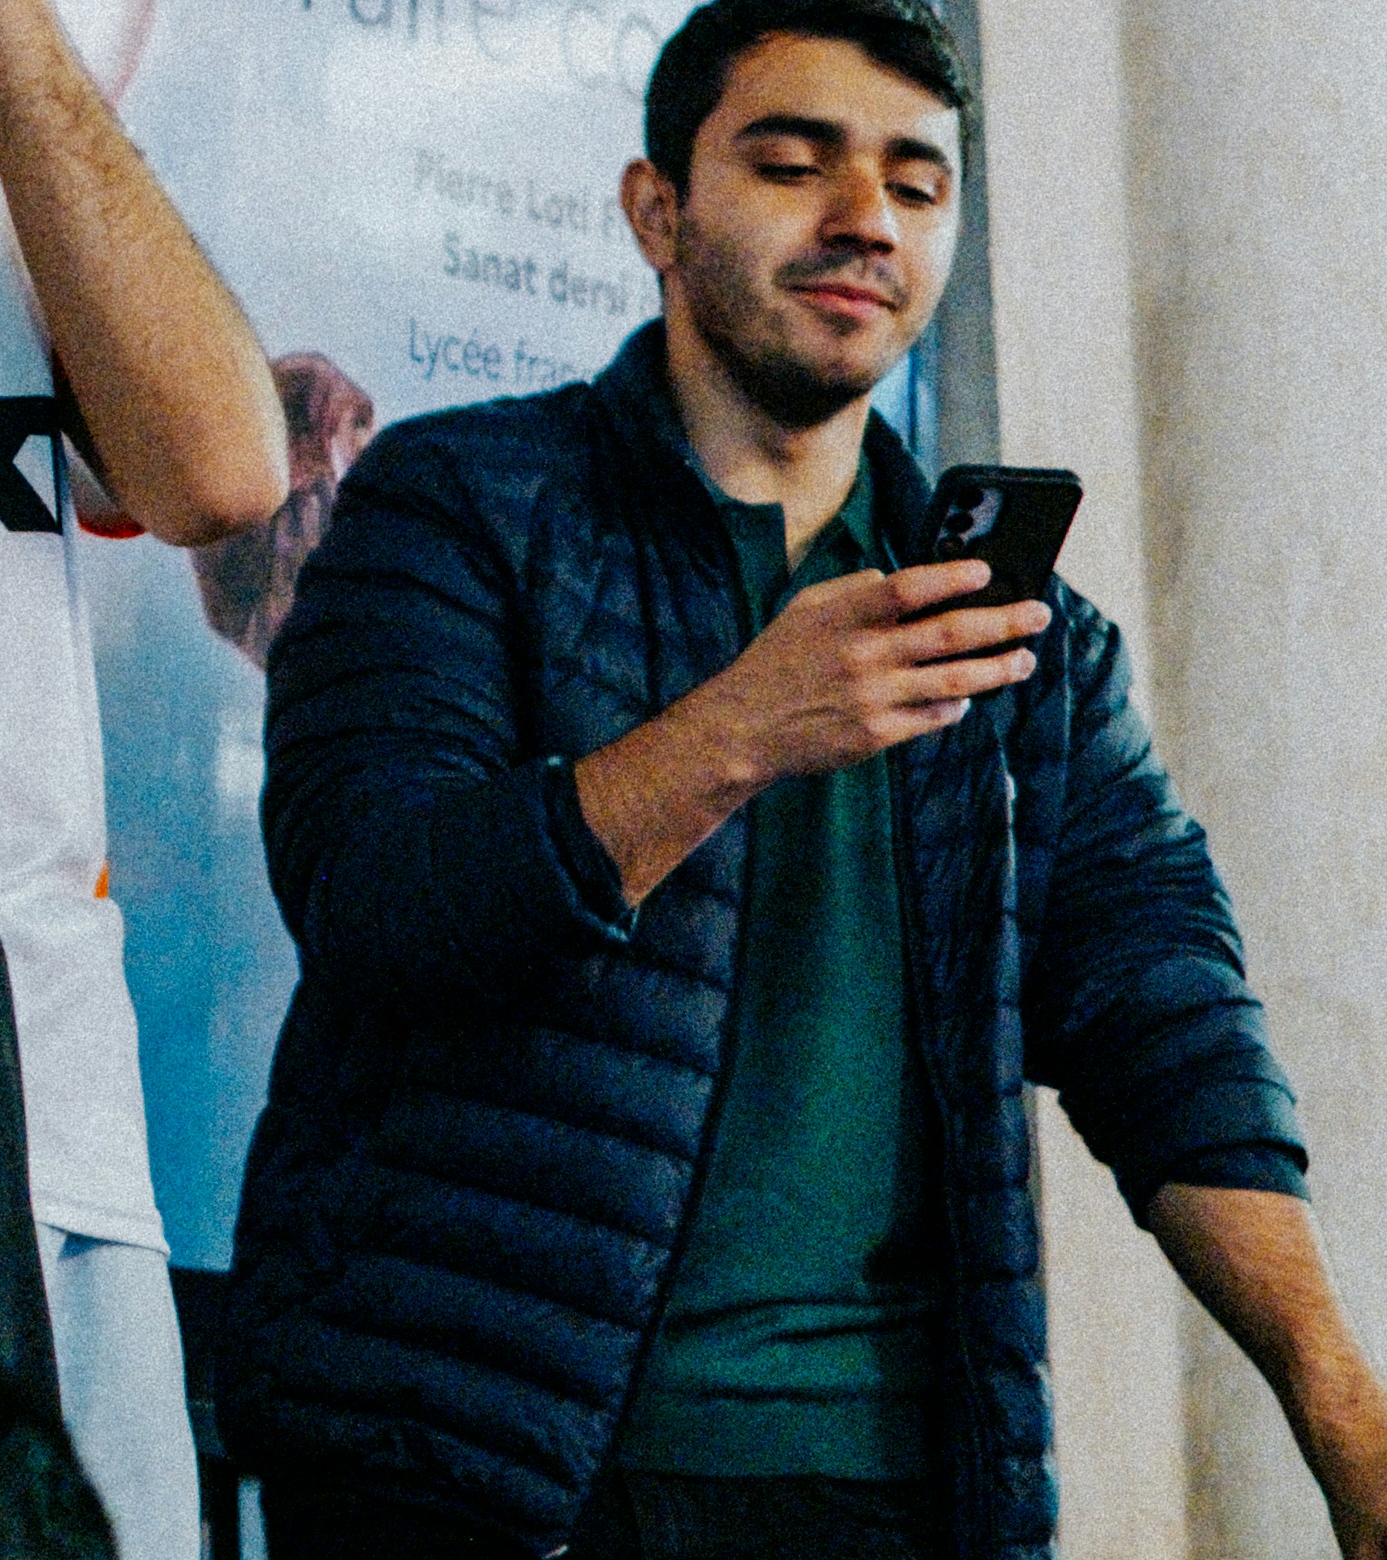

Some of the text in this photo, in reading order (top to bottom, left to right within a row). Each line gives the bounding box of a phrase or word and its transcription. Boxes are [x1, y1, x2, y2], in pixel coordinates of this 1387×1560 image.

[415, 147, 514, 216] Pierre
[442, 229, 537, 298] Sanat
[407, 316, 593, 383] Lycée fran
